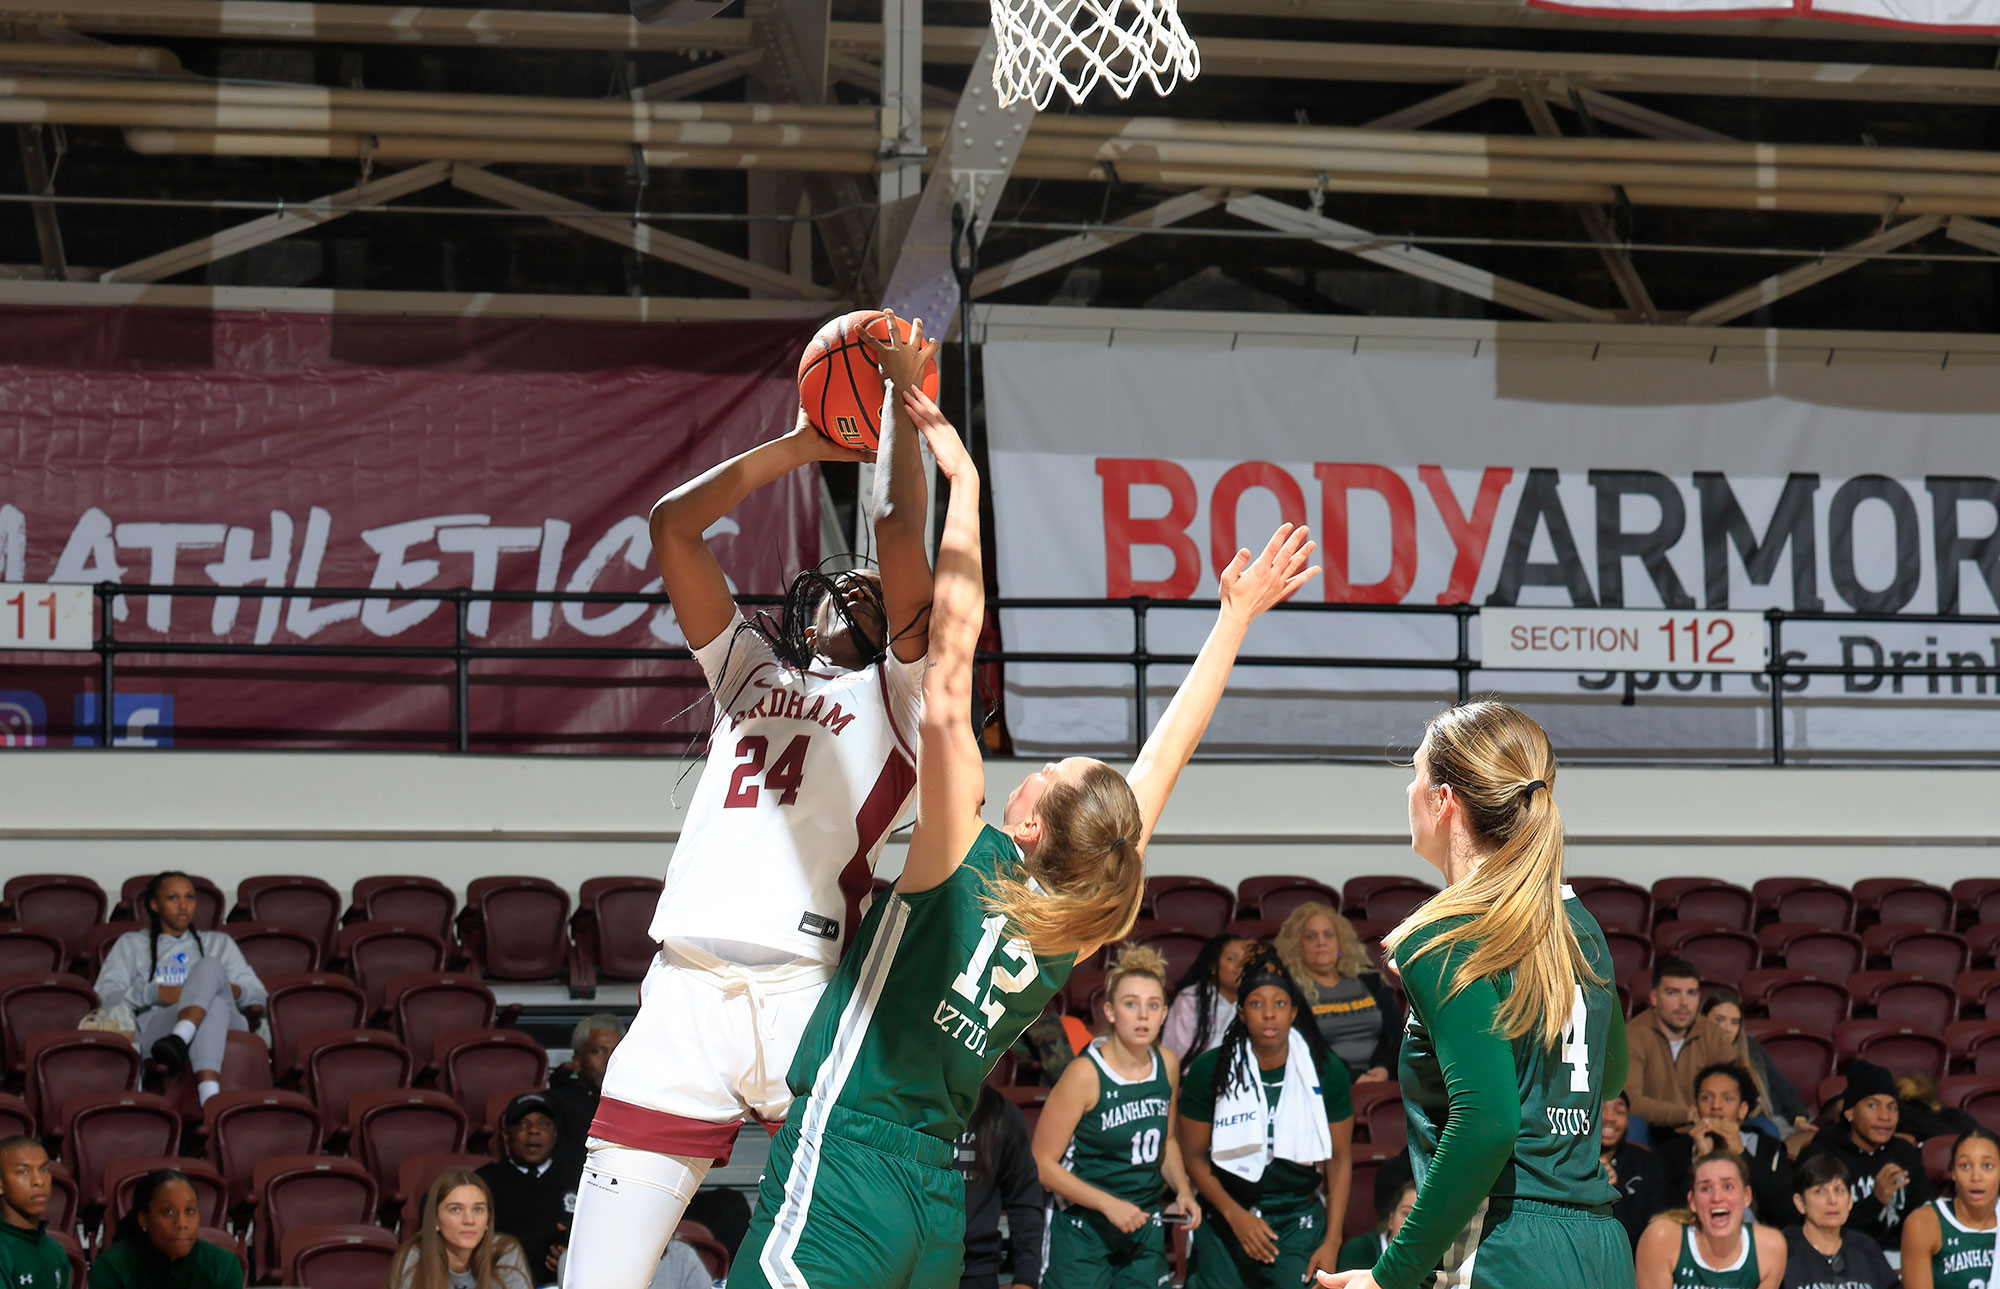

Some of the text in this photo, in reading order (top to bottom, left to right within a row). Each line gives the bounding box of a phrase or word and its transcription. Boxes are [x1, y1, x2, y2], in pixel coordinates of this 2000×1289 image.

[7, 591, 56, 640] 11
[1511, 618, 1735, 663] SECTION 112
[1839, 635, 2000, 695] Drin
[731, 688, 856, 736] RDHAM
[723, 735, 811, 809] 24
[951, 914, 1039, 1030] 12
[1561, 984, 1590, 1092] 4
[1131, 1128, 1161, 1166] 10
